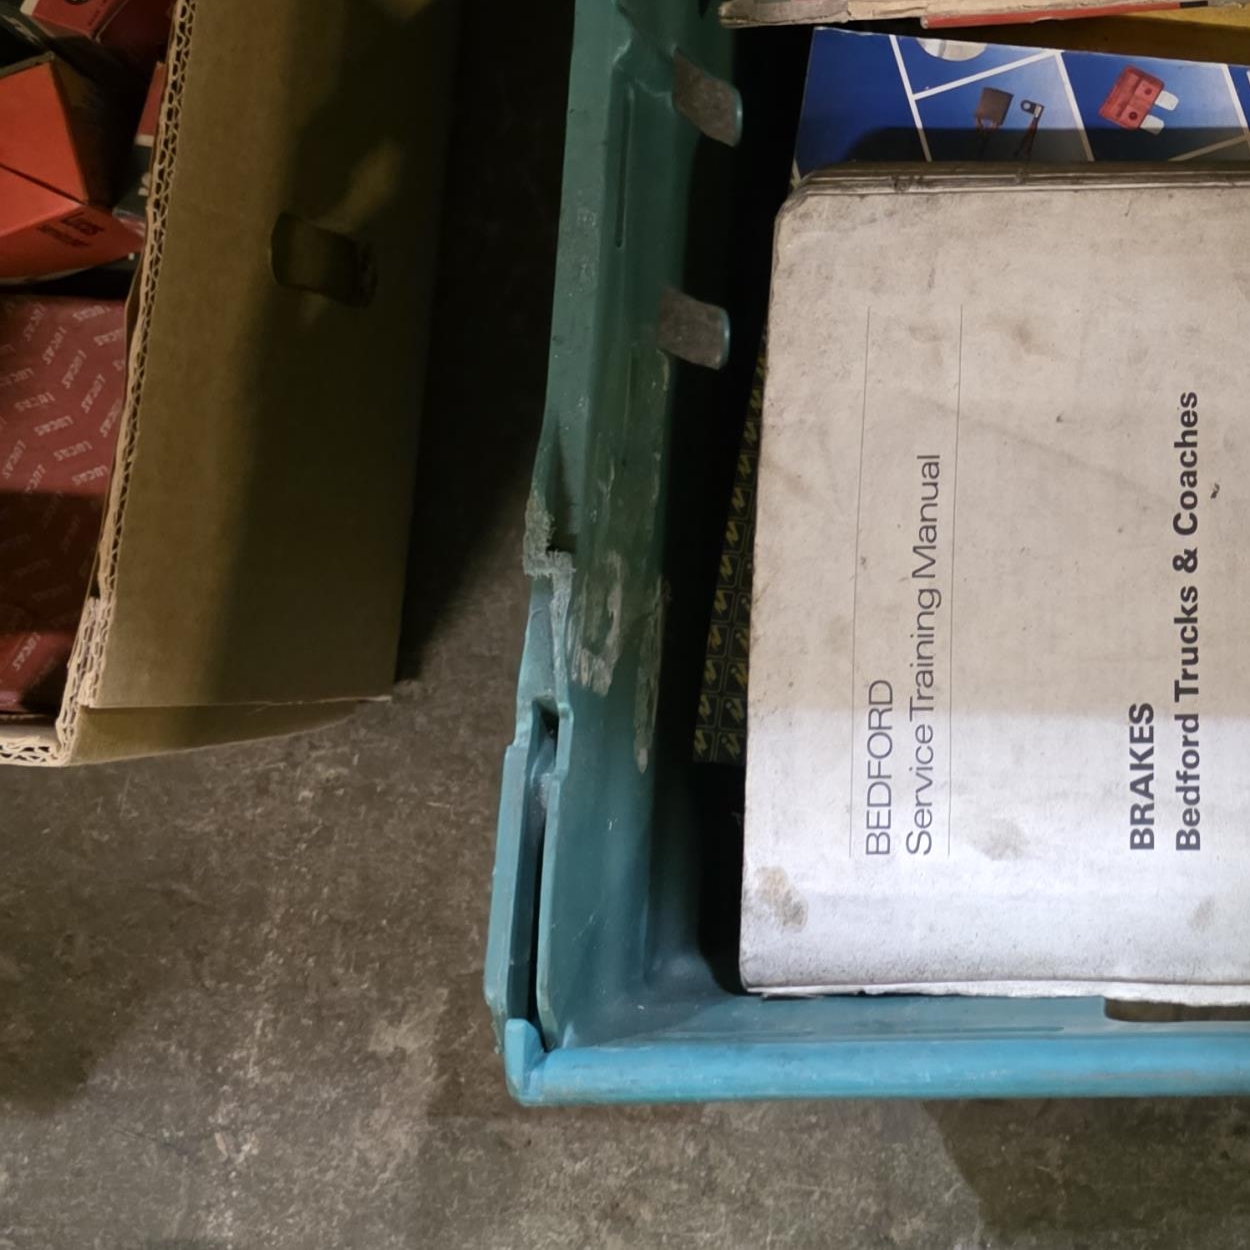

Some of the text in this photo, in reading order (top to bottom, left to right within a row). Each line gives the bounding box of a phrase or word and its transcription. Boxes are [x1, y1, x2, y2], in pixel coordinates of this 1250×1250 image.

[905, 454, 943, 858] Service Training Manual
[1173, 391, 1201, 852] Bedford Trucks & Coaches
[866, 679, 894, 857] BEDFORD
[1129, 702, 1155, 851] BRAKES
